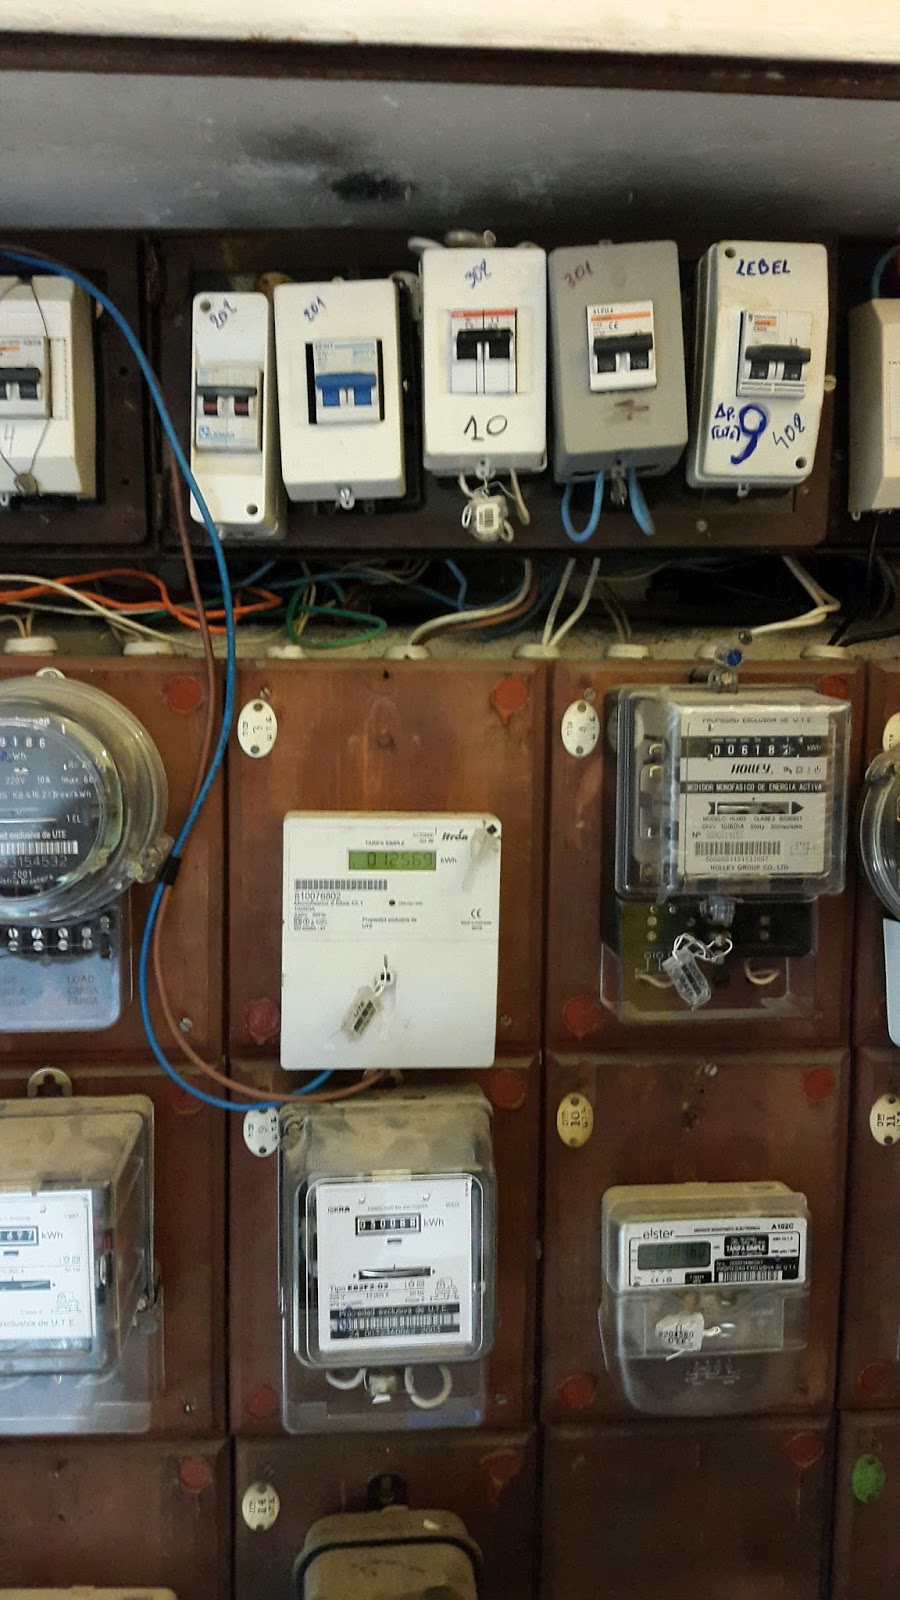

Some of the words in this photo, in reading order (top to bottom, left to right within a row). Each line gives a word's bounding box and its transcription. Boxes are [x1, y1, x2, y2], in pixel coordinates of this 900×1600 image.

[736, 258, 791, 276] LEBEL
[463, 414, 508, 441] 10
[730, 403, 767, 464] 9
[757, 782, 766, 791] DE
[768, 782, 797, 791] ENERGIA
[799, 782, 823, 791] ACTIVA
[51, 829, 67, 840] UTE
[440, 856, 457, 864] kWh
[737, 864, 761, 872] GROUP
[423, 1218, 445, 1228] kWh
[41, 1231, 64, 1240] kWh
[642, 1227, 674, 1239] elster
